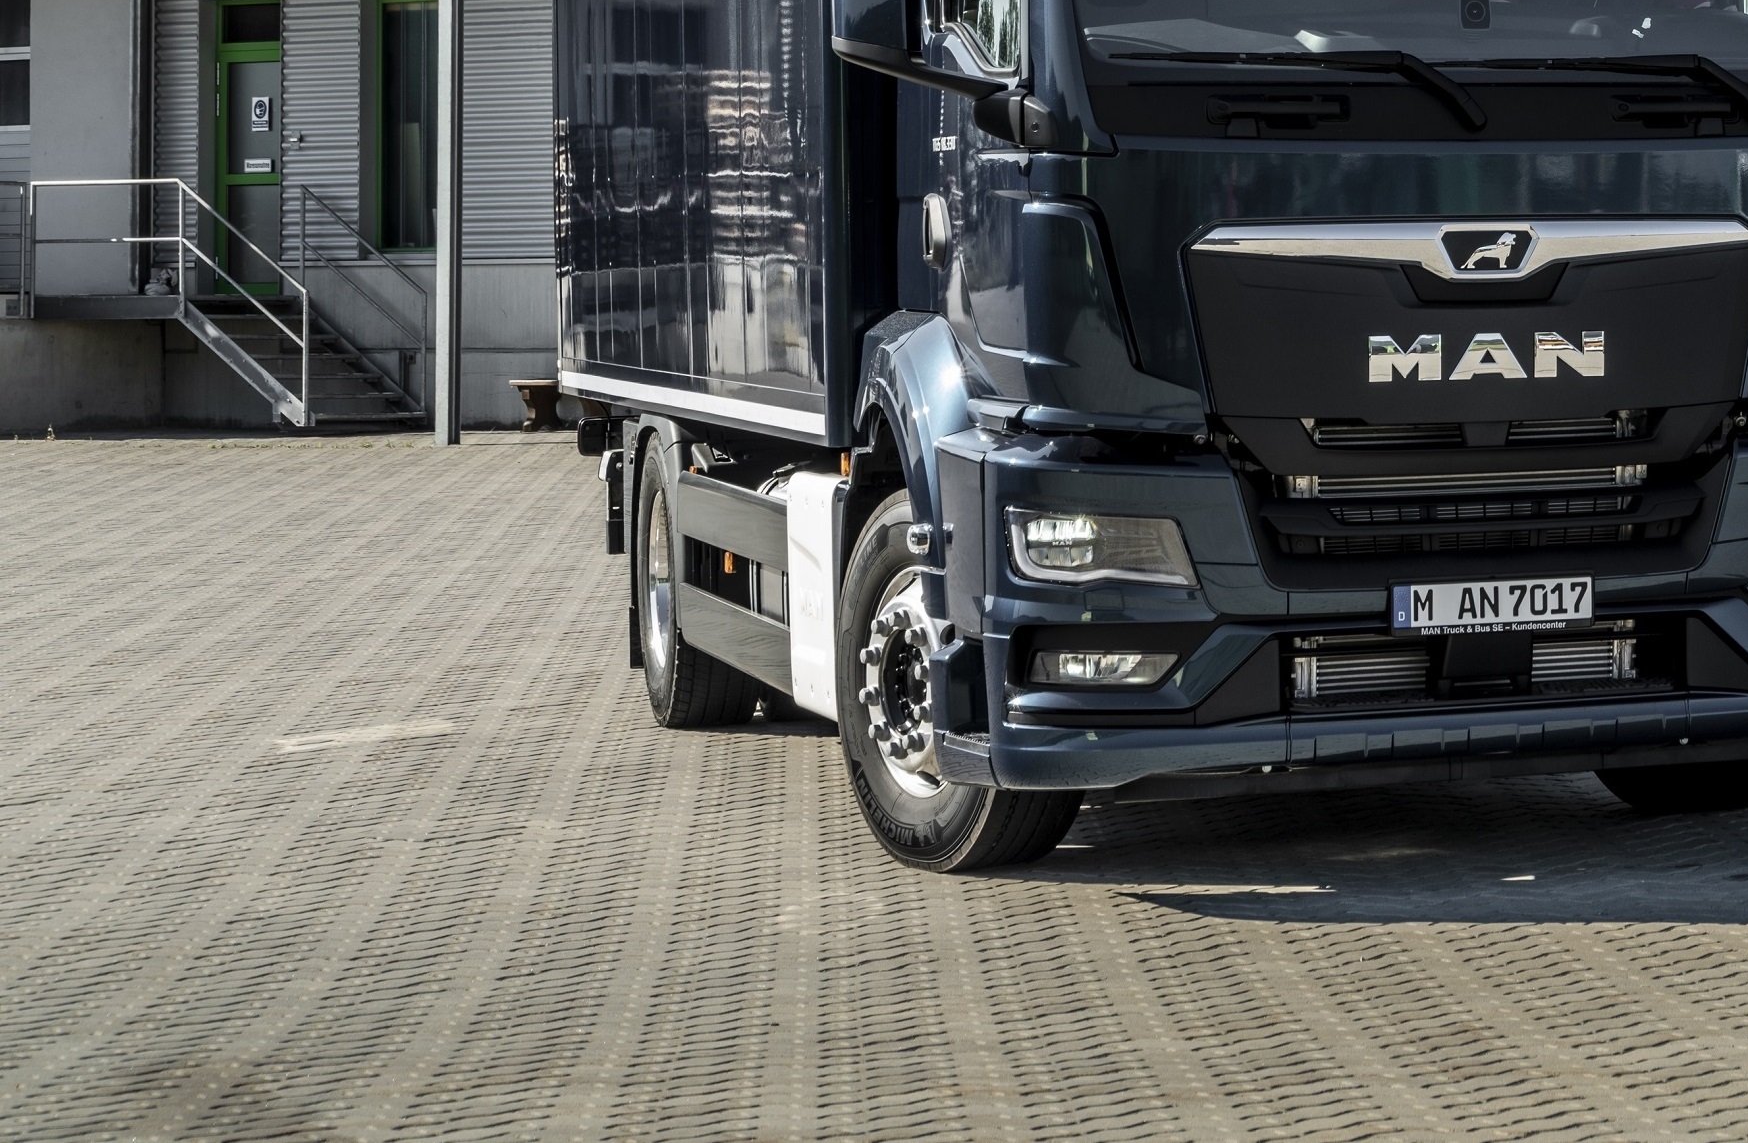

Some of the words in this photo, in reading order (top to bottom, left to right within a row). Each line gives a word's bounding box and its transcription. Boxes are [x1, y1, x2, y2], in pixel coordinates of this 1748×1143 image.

[1368, 331, 1605, 382] MAN
[1399, 611, 1406, 621] D
[1413, 589, 1433, 622] M
[1458, 586, 1500, 620] AN
[1509, 581, 1589, 617] 7017
[1421, 627, 1441, 635] MAN
[1443, 625, 1465, 634] Truck
[1466, 625, 1473, 633] &
[1474, 624, 1491, 633] Bus
[1492, 623, 1504, 631] SE
[1512, 621, 1567, 631] Kundencenter
[856, 776, 915, 846] MICHELIN
